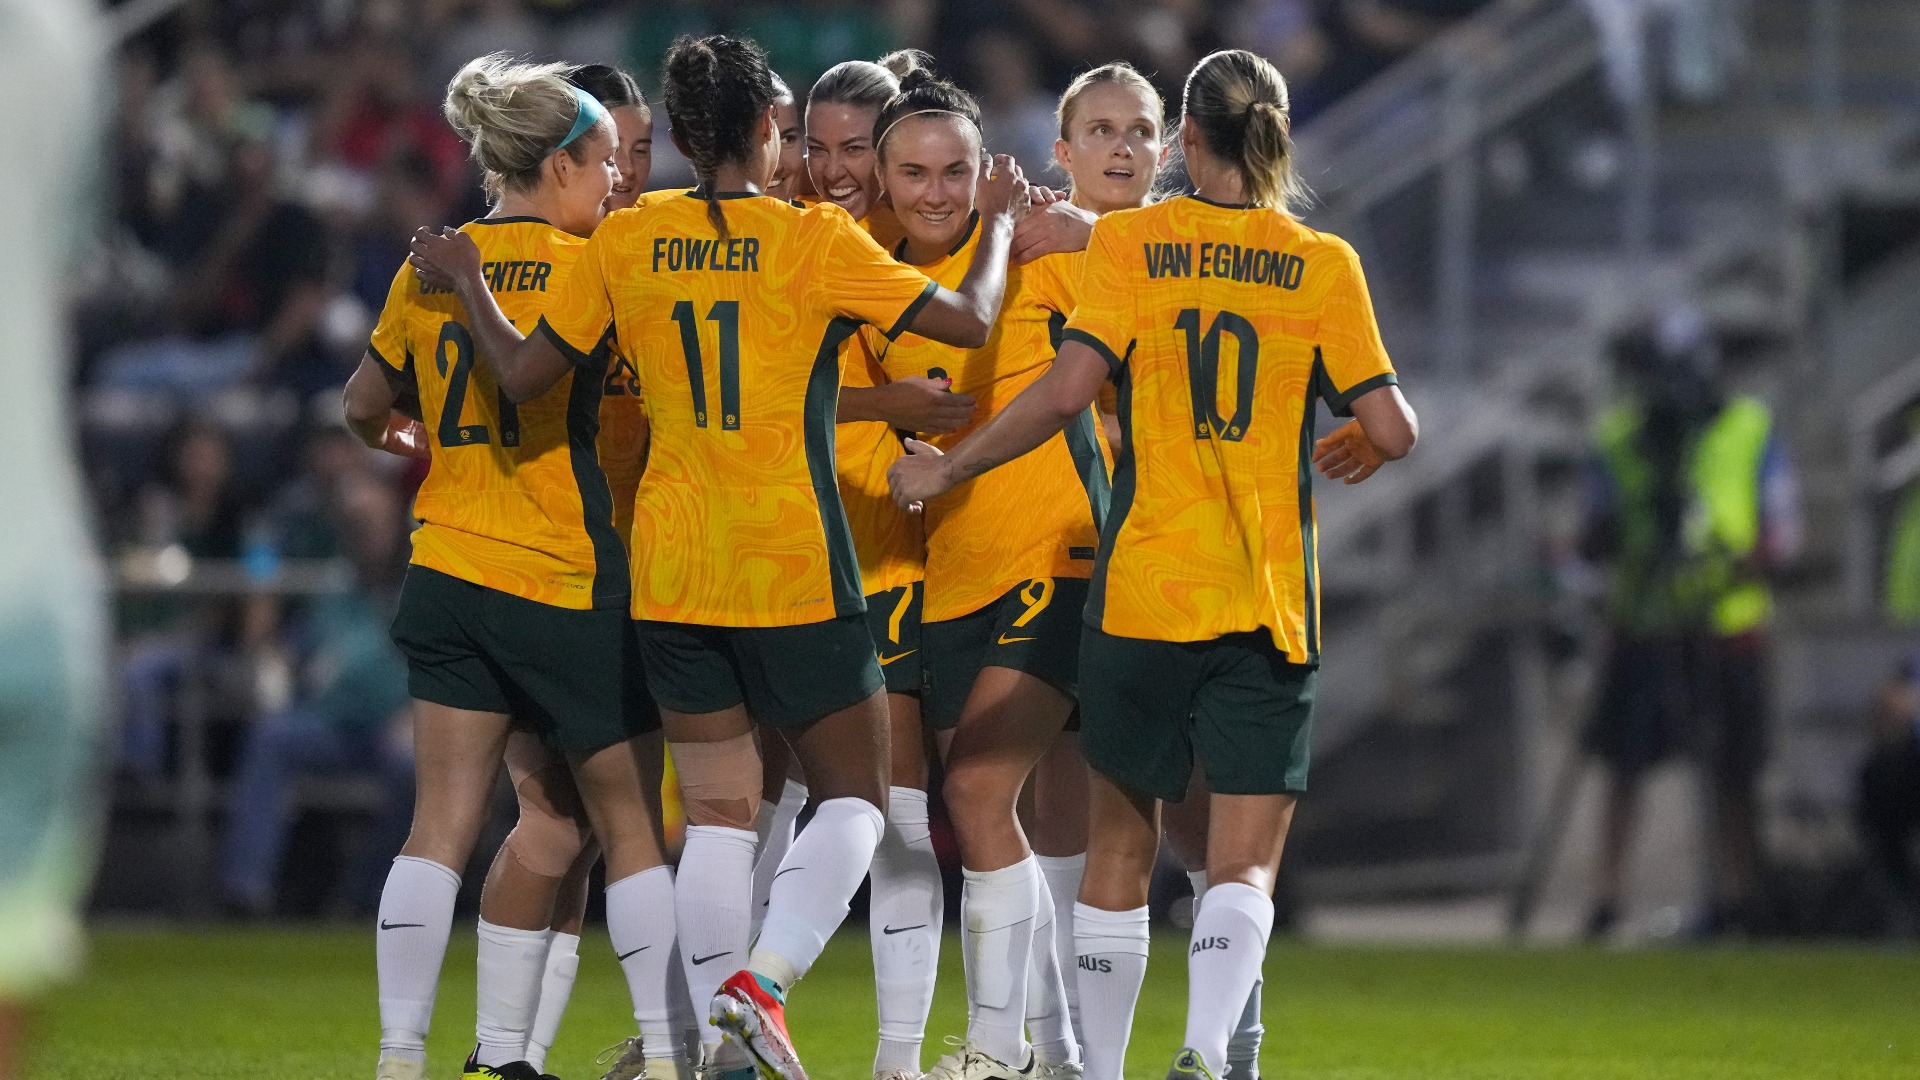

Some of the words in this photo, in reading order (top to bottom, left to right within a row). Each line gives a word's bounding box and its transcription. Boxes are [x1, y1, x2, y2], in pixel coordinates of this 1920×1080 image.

[419, 261, 552, 295] ENTER
[652, 237, 760, 273] FOWLER
[1144, 242, 1192, 279] VAN
[1200, 243, 1306, 291] EGMOND
[670, 300, 741, 431] 11
[1173, 308, 1260, 443] 10
[886, 582, 914, 645] 7
[1012, 577, 1056, 628] 9
[1078, 955, 1112, 973] AUS
[1191, 936, 1231, 958] AUS
